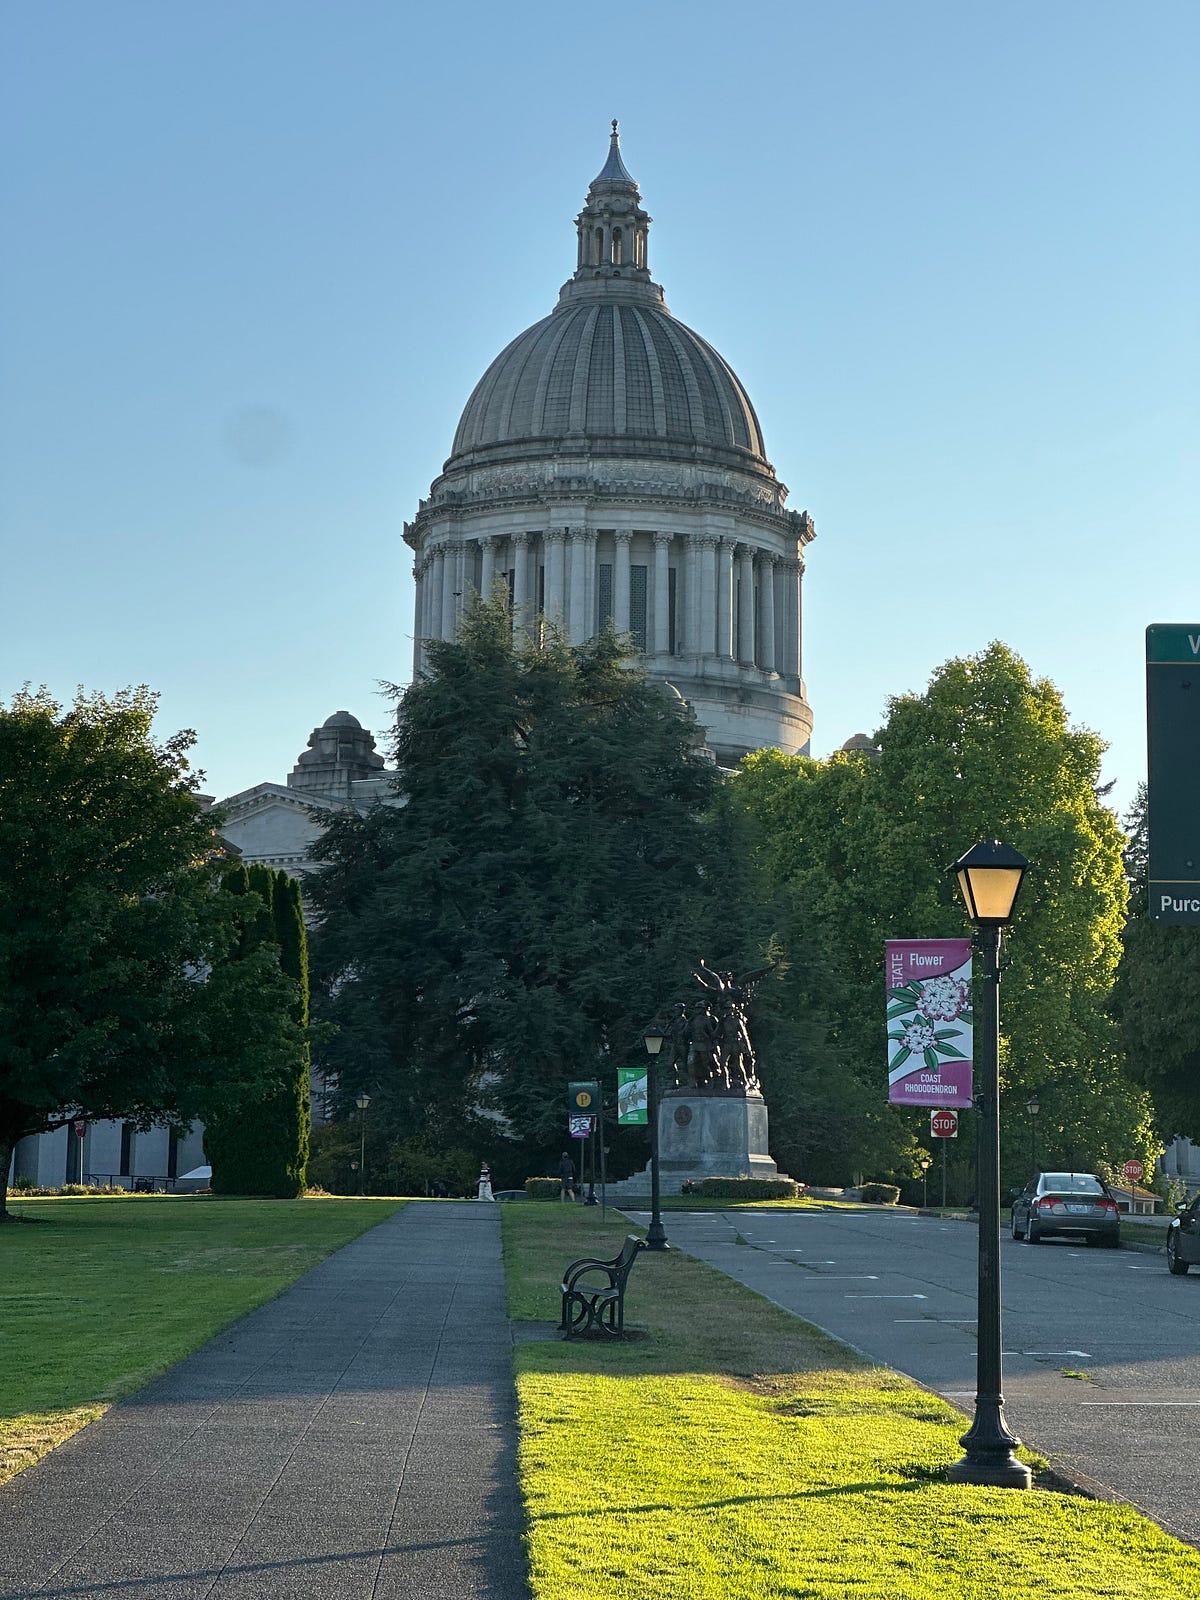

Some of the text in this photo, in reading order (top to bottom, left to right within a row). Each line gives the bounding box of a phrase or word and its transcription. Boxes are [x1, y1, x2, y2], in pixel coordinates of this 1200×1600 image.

[1161, 895, 1200, 912] Purc
[910, 953, 944, 966] Flower
[920, 1073, 941, 1083] COAST
[904, 1083, 958, 1095] RHODODENDRON
[933, 1119, 956, 1129] STOP
[1125, 1165, 1142, 1175] STOP
